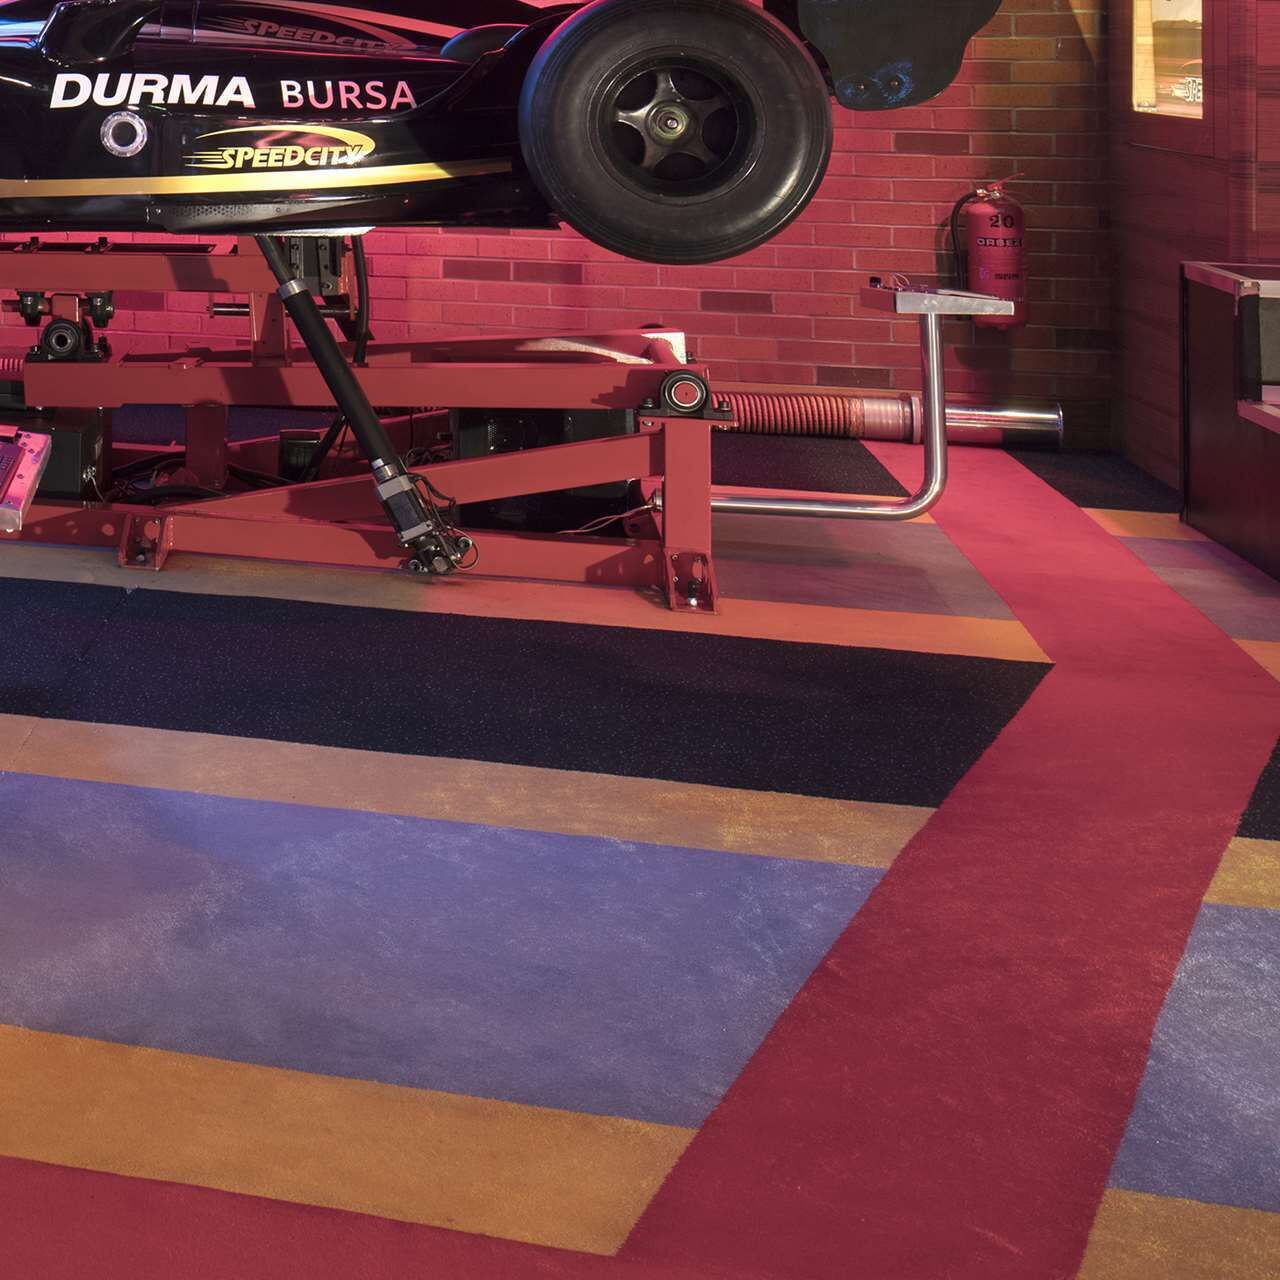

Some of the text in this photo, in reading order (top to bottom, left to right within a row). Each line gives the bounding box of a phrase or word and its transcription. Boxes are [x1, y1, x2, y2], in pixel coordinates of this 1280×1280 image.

[48, 72, 419, 111] DURMA BURSA
[220, 144, 364, 170] SPEEDCITY
[989, 214, 1015, 229] 20
